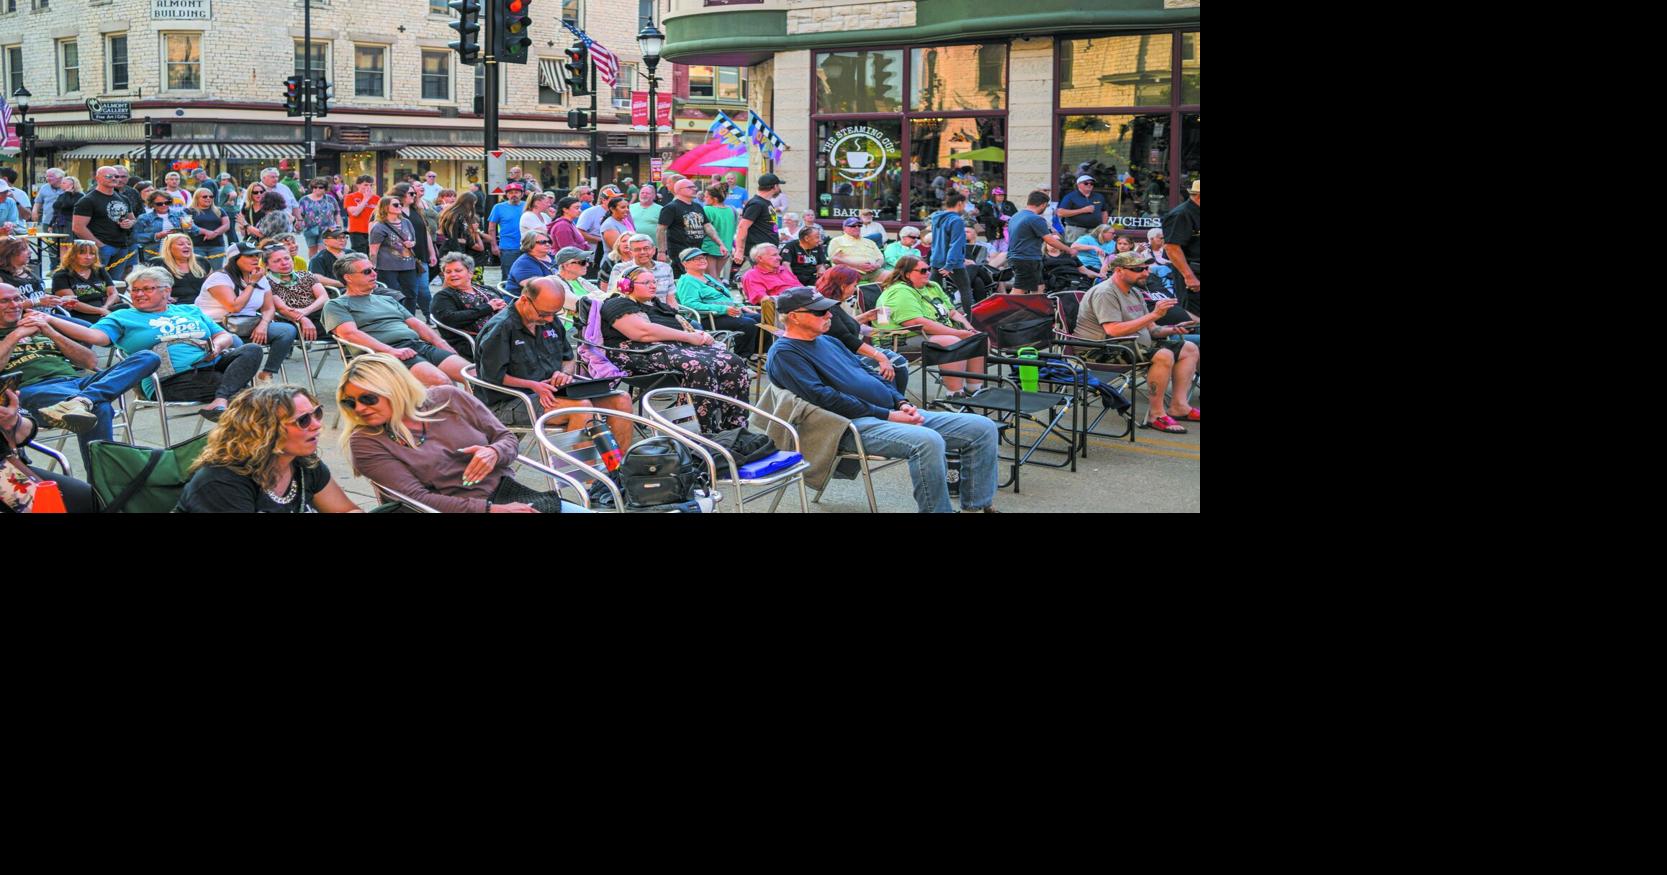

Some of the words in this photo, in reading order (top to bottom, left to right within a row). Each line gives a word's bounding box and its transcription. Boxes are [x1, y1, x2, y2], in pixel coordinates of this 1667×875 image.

[156, 0, 204, 8] ALMONT
[823, 137, 836, 153] THE
[836, 126, 884, 140] STEAMING
[882, 138, 895, 154] CUP
[833, 208, 881, 218] BAKY
